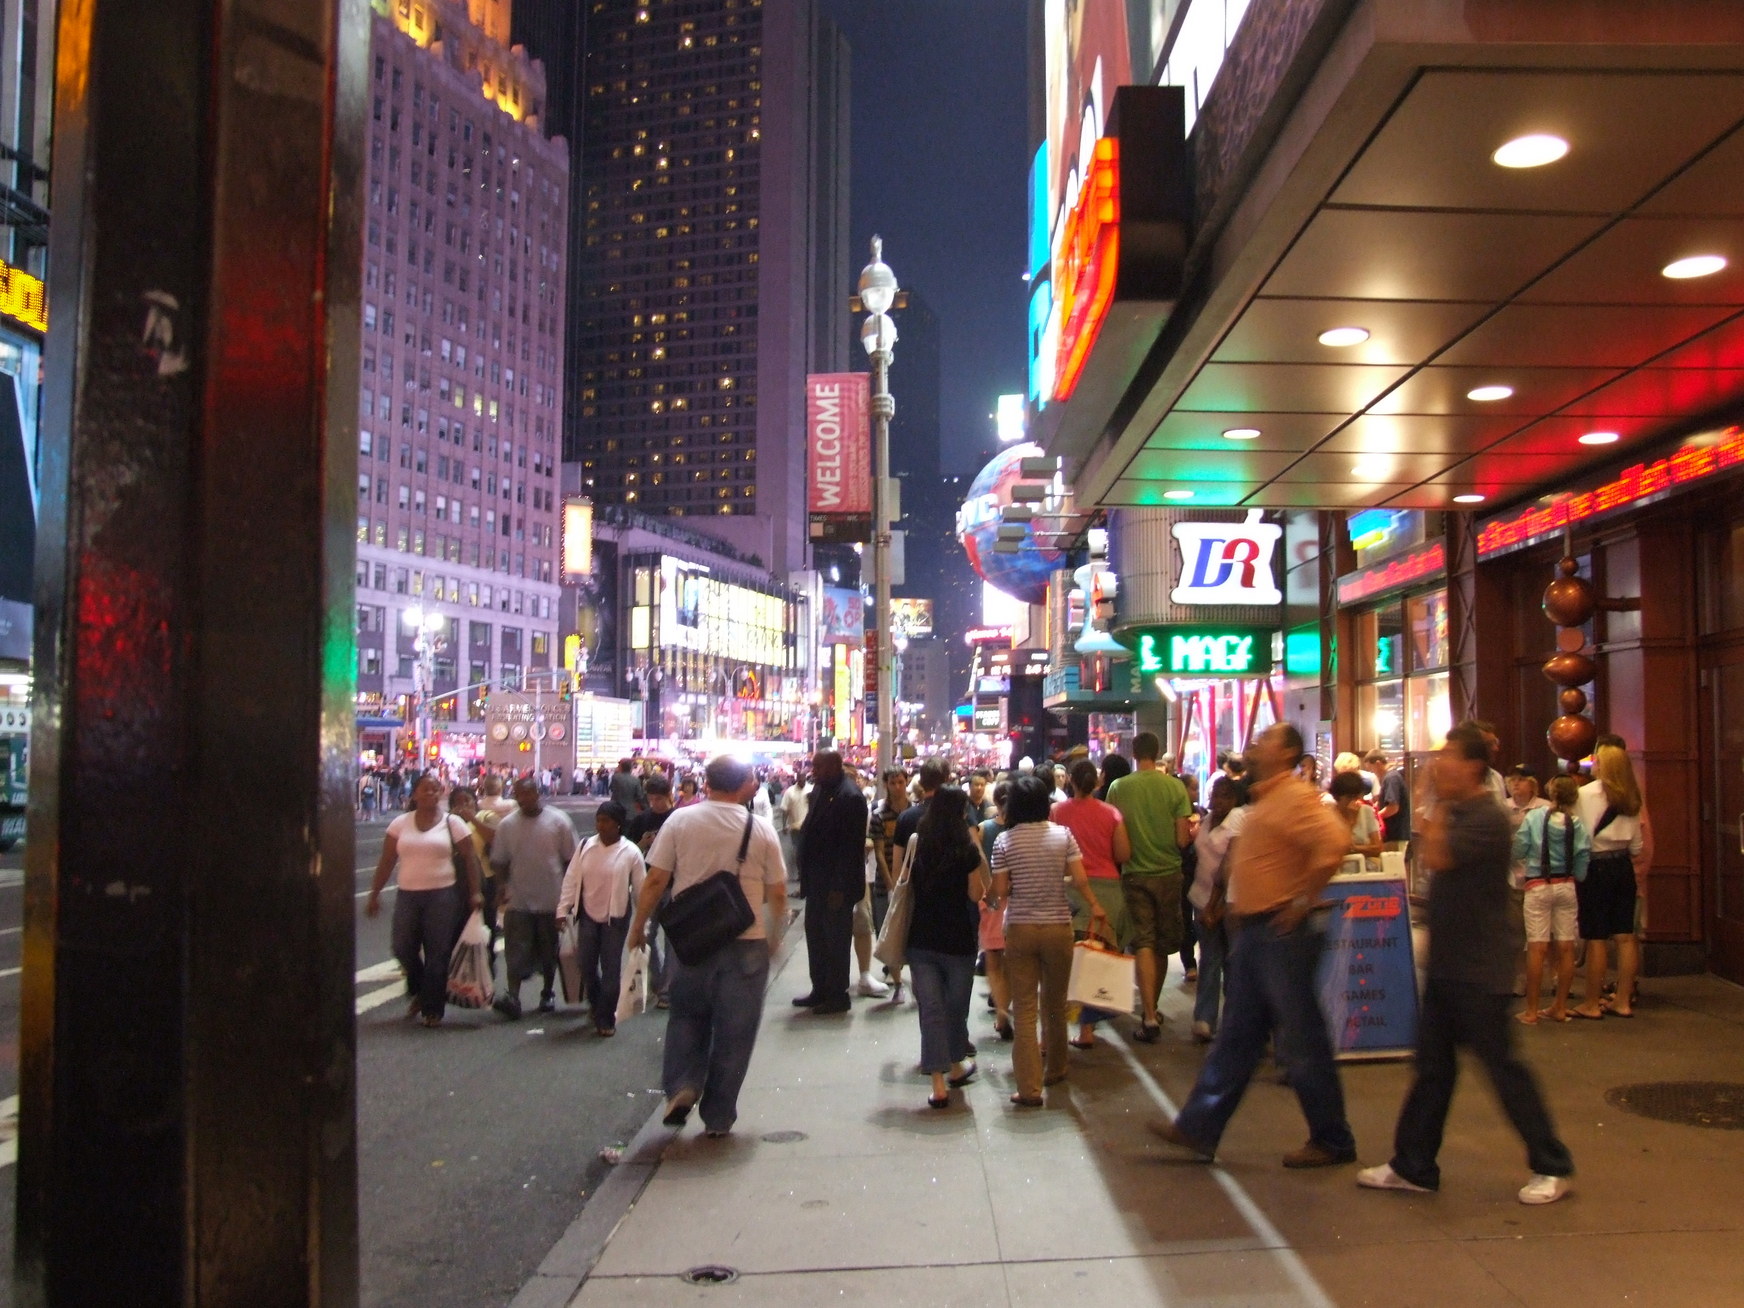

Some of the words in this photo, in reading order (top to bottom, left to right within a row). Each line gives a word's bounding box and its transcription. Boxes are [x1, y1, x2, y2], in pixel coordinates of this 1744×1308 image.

[815, 383, 842, 507] WELCOME
[1189, 538, 1260, 588] DR
[1324, 937, 1398, 951] ESTAURANT
[1348, 963, 1374, 976] BAR
[1341, 989, 1386, 1001] GAMES
